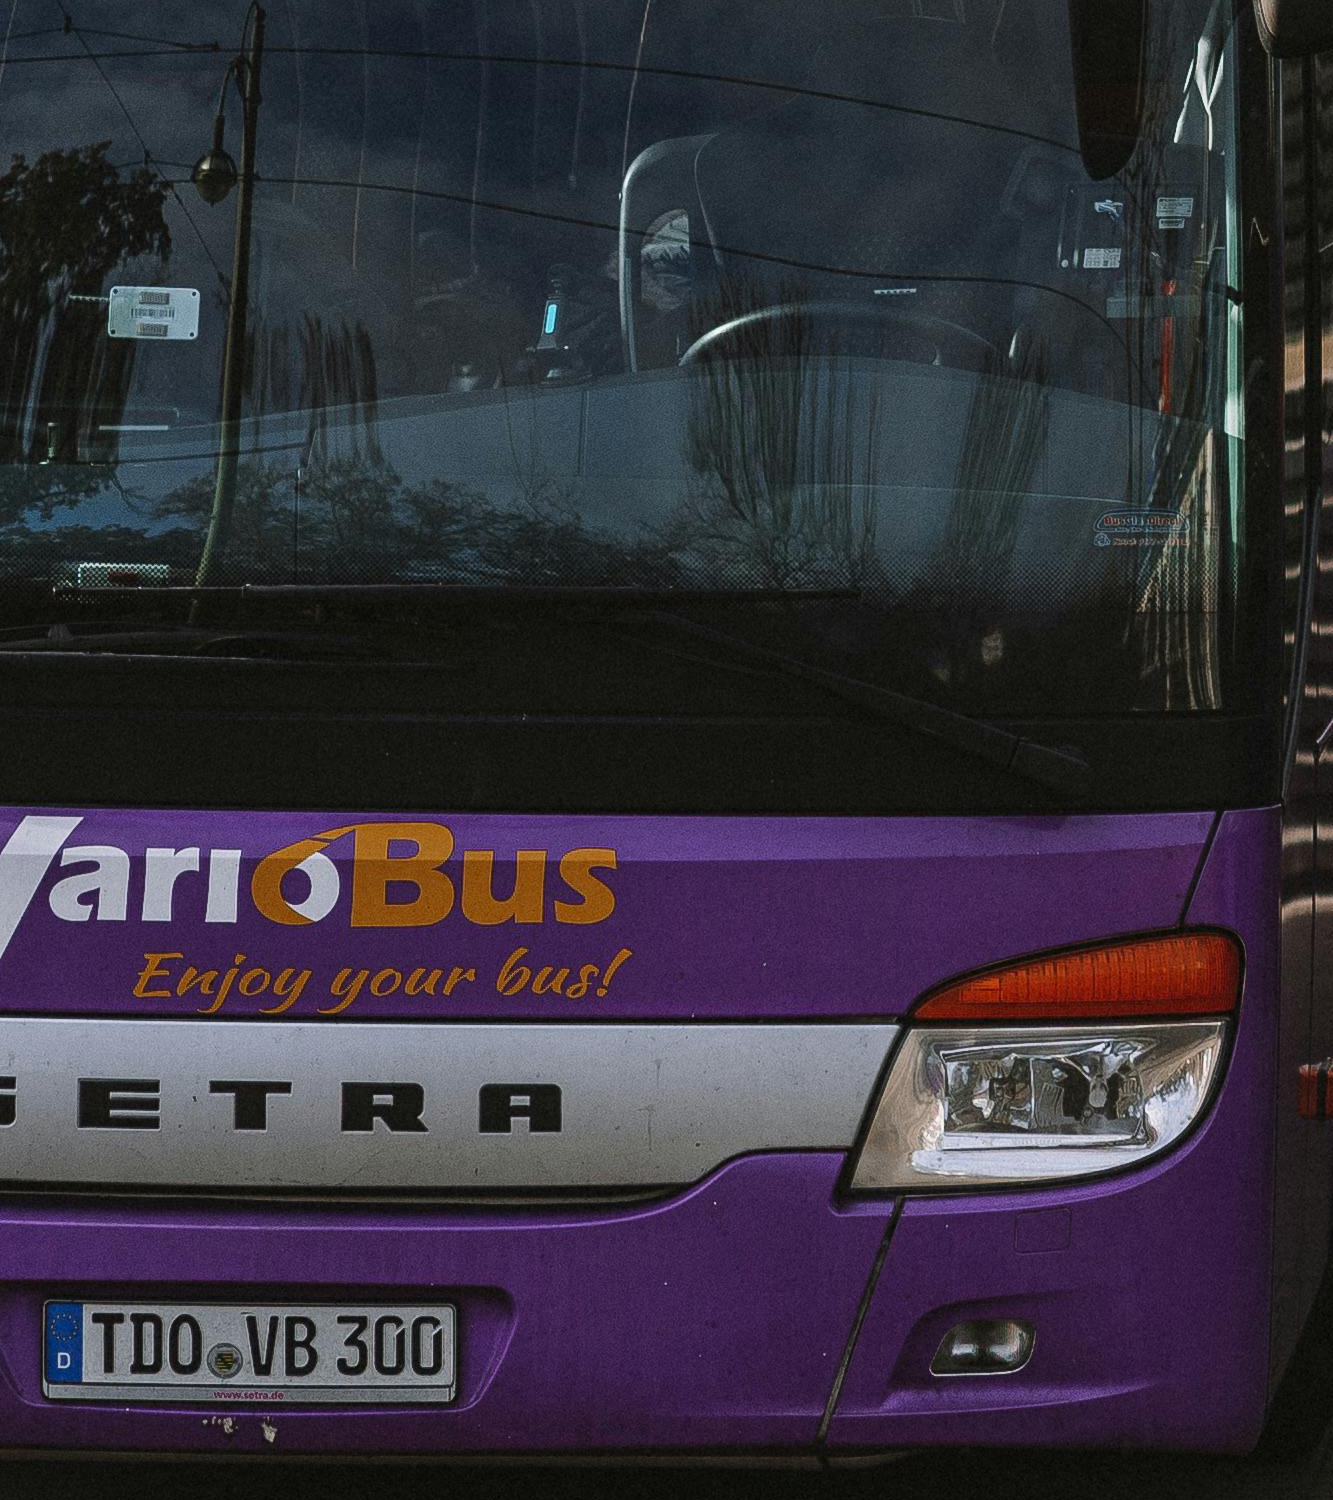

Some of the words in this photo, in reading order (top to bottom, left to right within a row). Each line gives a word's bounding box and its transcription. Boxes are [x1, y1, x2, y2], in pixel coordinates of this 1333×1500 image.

[132, 952, 312, 1014] Enjoy
[317, 967, 476, 1014] your
[496, 946, 633, 999] bus!
[0, 1075, 563, 1134] ETRA
[57, 1352, 71, 1369] D
[92, 1312, 202, 1375] TDO
[246, 1315, 318, 1377] VB
[336, 1315, 443, 1377] 300
[213, 1391, 285, 1400] www.setra.de
